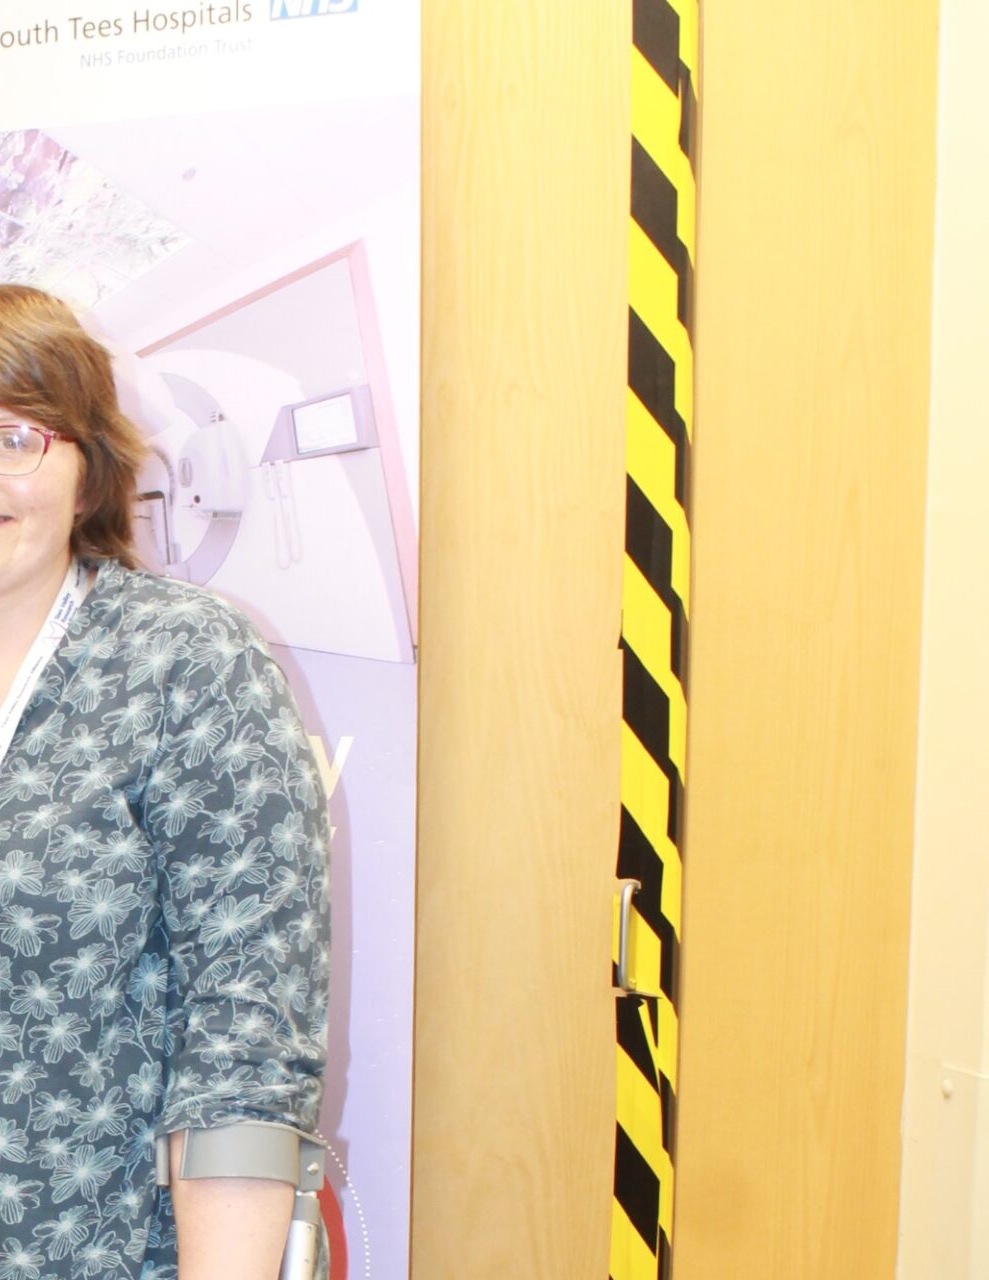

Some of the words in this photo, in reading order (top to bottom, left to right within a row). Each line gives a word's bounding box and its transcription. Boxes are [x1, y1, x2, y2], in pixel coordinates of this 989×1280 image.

[68, 15, 122, 40] Tees
[133, 0, 251, 33] Hospitals
[80, 51, 112, 68] NHS
[117, 43, 210, 65] Foundation
[216, 37, 256, 54] Trust
